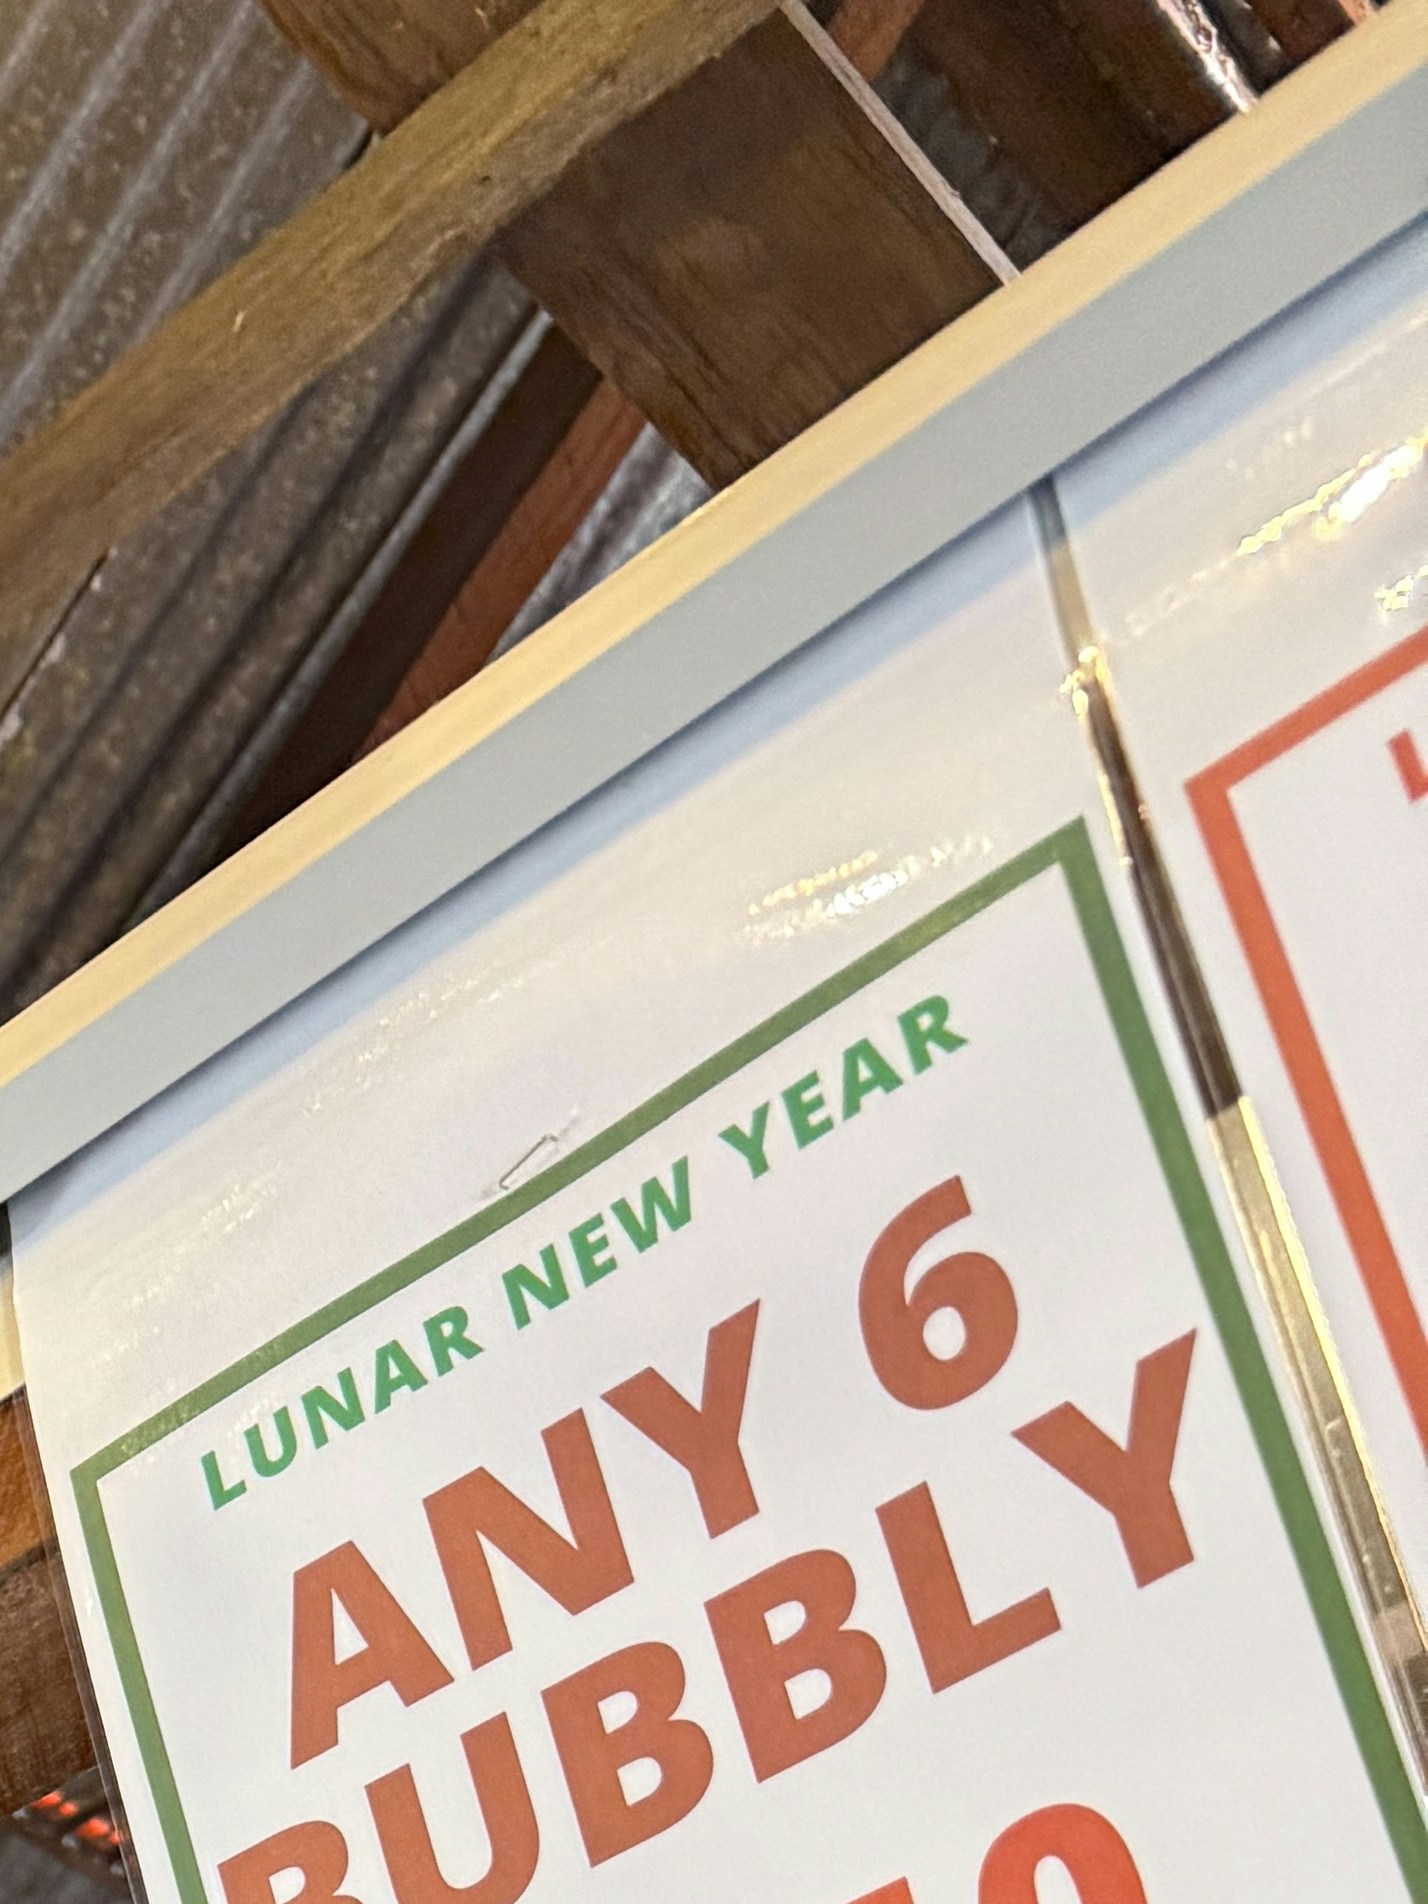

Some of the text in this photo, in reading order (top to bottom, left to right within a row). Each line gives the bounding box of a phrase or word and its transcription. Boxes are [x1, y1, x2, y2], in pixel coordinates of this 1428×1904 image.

[199, 992, 970, 1511] LUNAR NEW YEAR
[290, 1176, 1020, 1770] ANY 6
